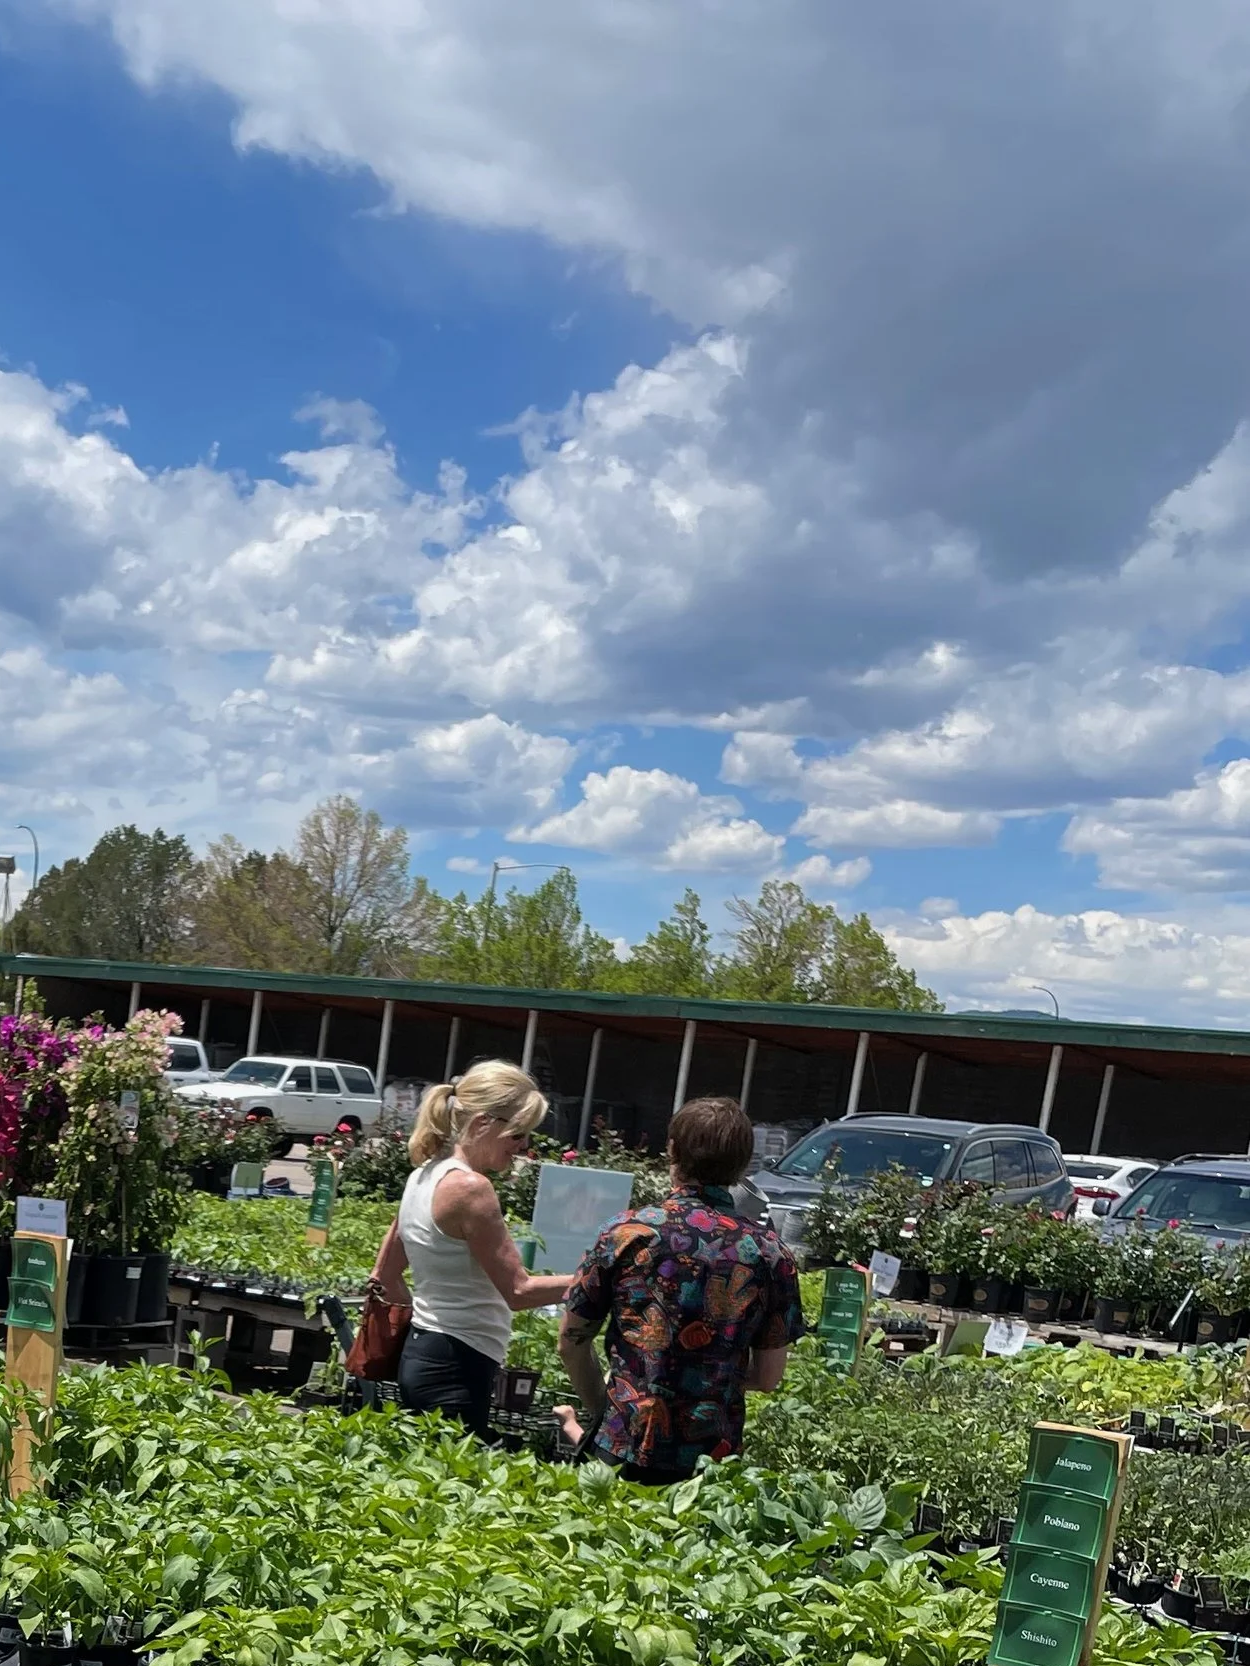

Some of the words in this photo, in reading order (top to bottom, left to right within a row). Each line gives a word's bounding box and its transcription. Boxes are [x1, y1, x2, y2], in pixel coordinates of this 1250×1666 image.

[1055, 1456, 1092, 1472] Jalapeno
[1043, 1514, 1080, 1532] Poblano
[1030, 1572, 1070, 1590] Cayenne
[1020, 1629, 1058, 1647] Shishito
